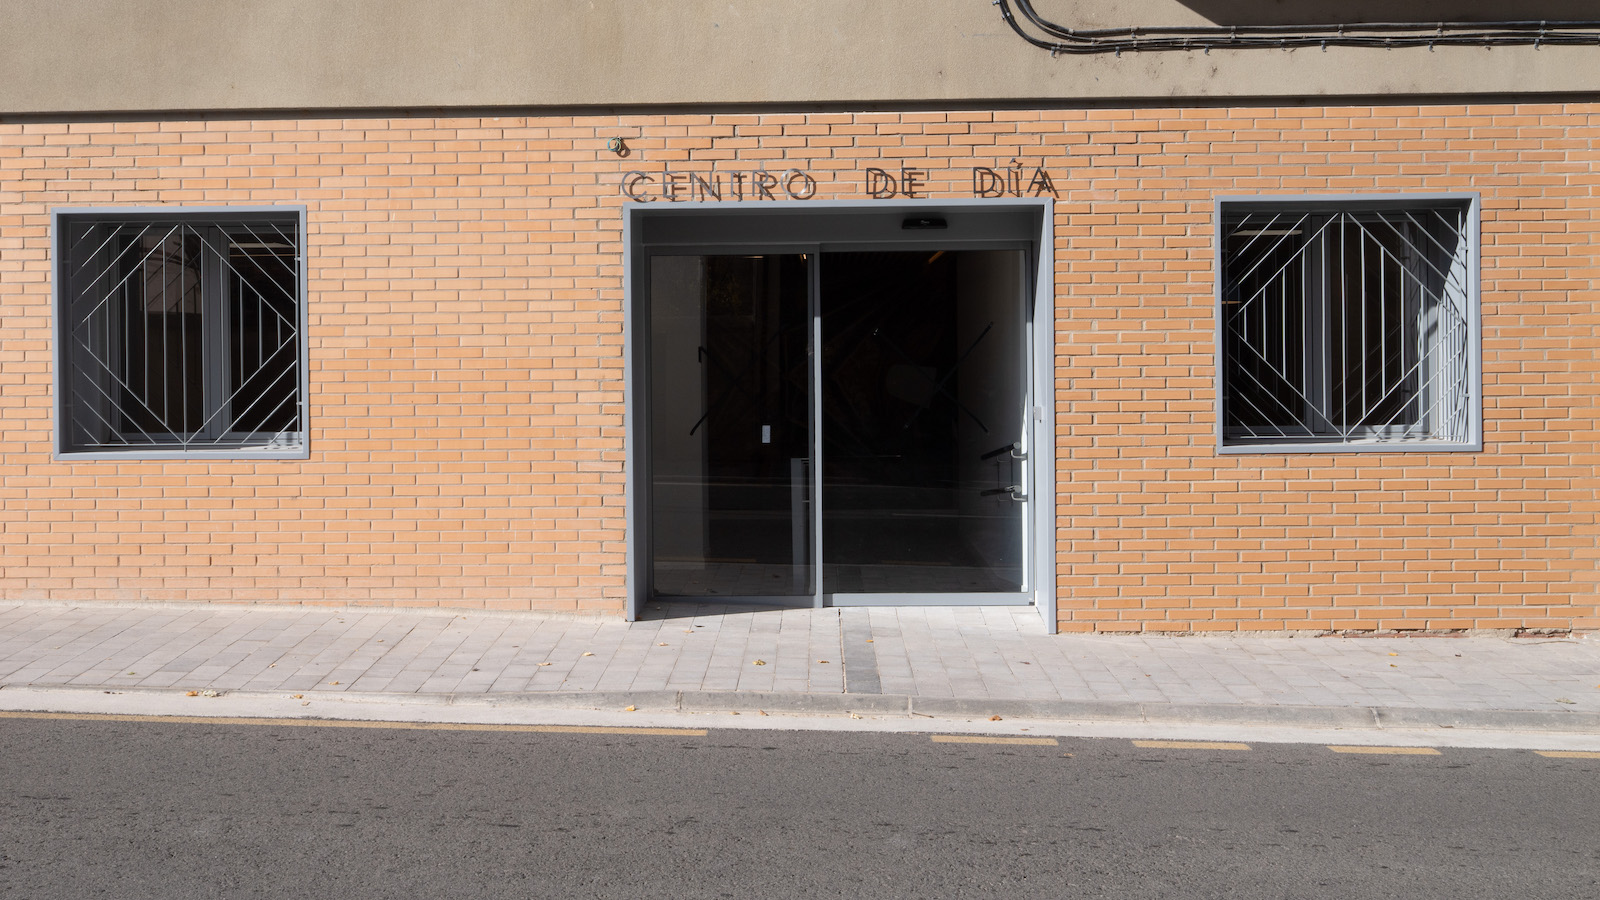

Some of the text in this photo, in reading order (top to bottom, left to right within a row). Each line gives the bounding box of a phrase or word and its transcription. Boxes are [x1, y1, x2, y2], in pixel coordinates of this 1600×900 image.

[622, 158, 1051, 199] CENTRO DE DÍA
